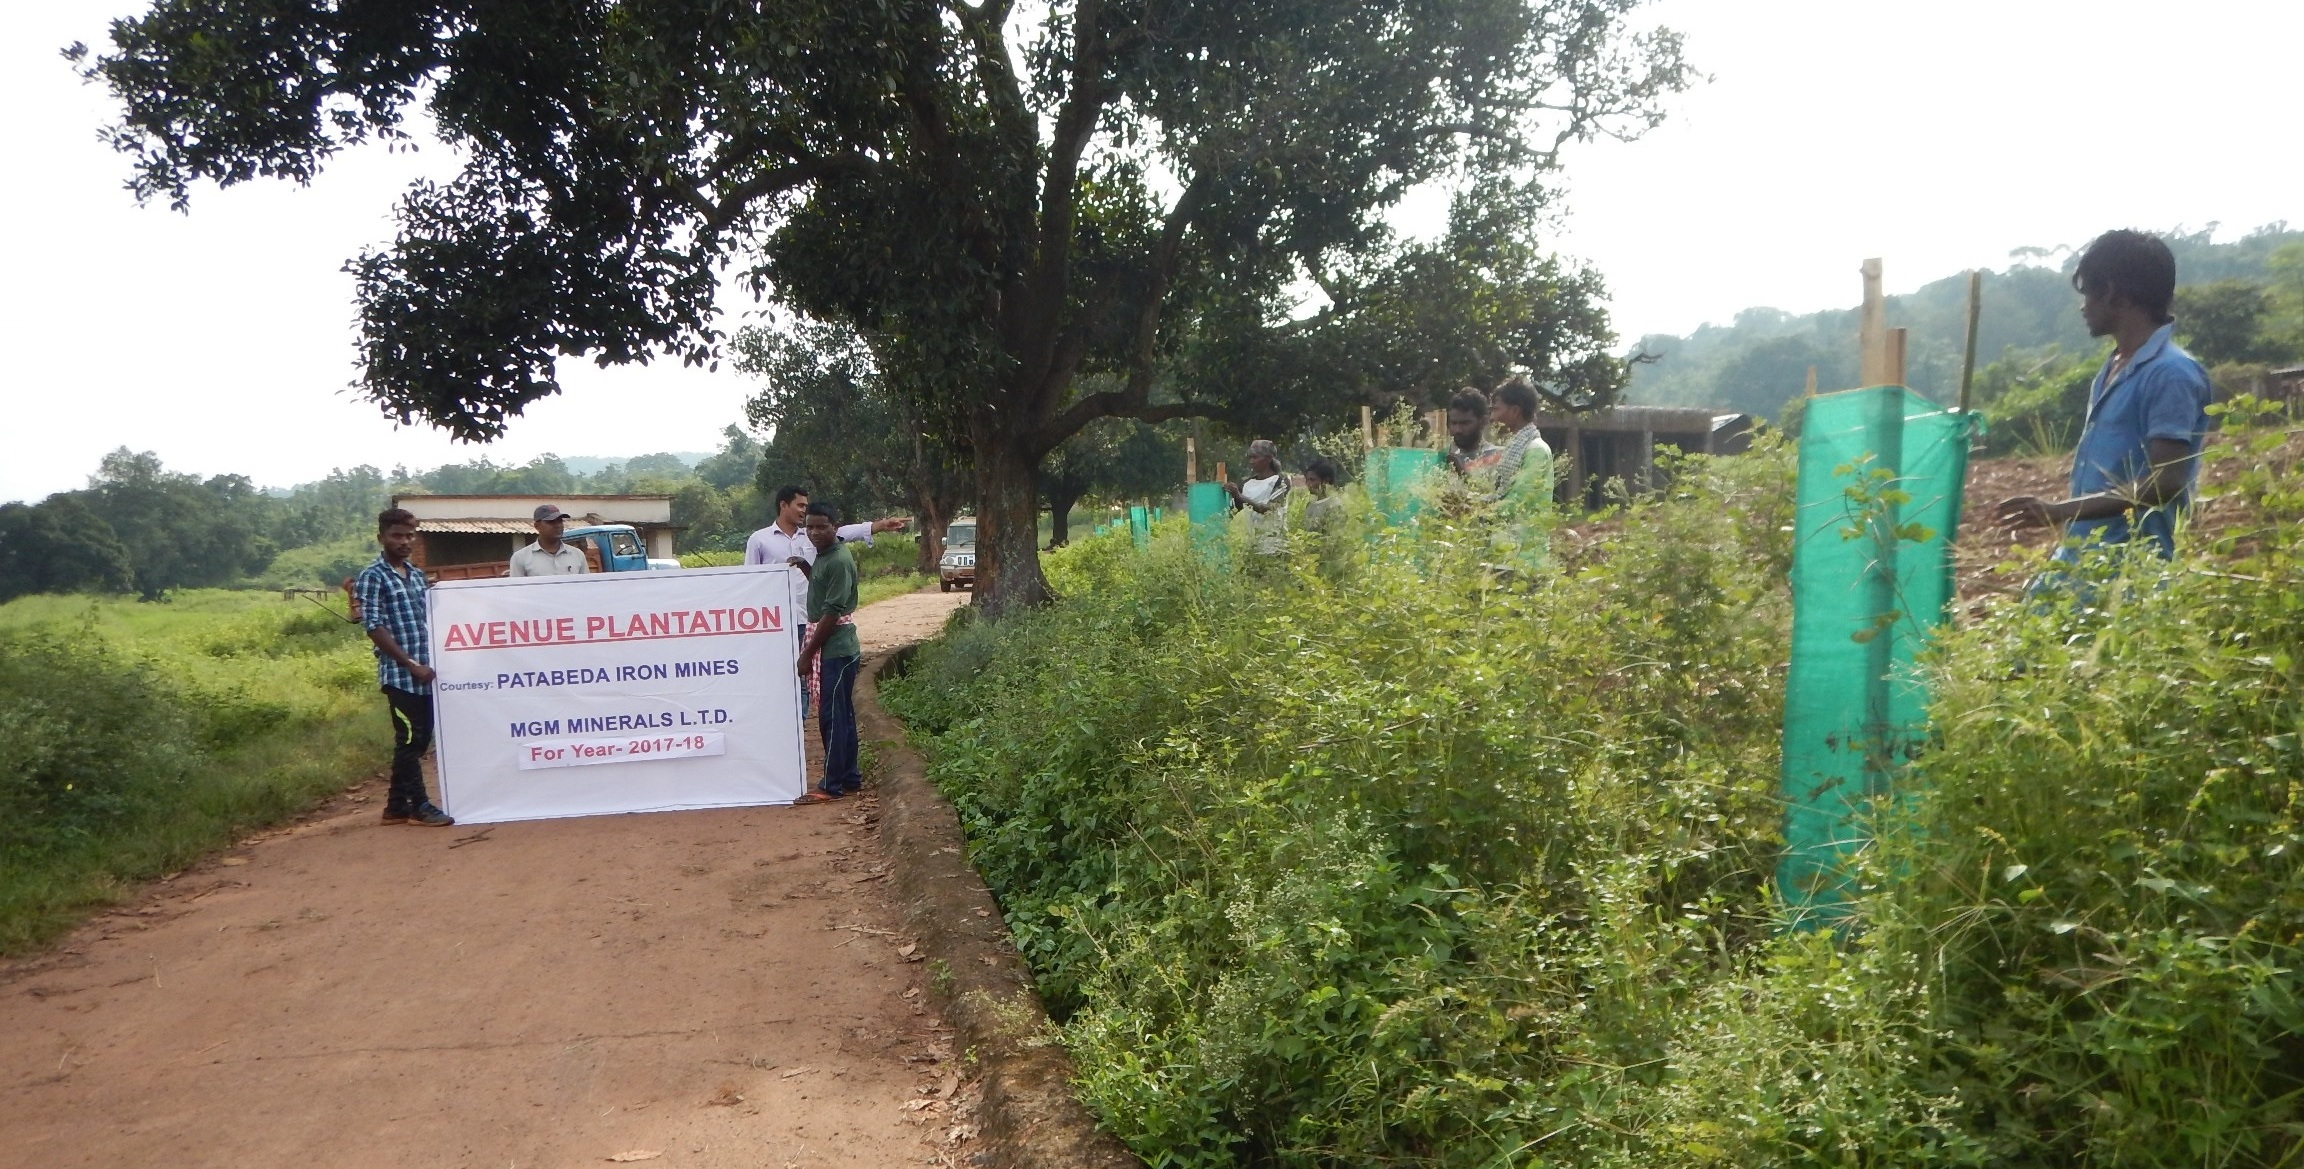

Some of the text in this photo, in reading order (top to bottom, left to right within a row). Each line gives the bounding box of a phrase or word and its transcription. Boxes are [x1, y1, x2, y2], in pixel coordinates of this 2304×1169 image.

[444, 606, 781, 647] AVENUE PLANTATION
[440, 659, 739, 692] Courtesy: PATABEDA IRON MINES
[510, 708, 733, 738] MGM MINERALS L.T.D.
[531, 735, 705, 761] For Year- 2017-18
